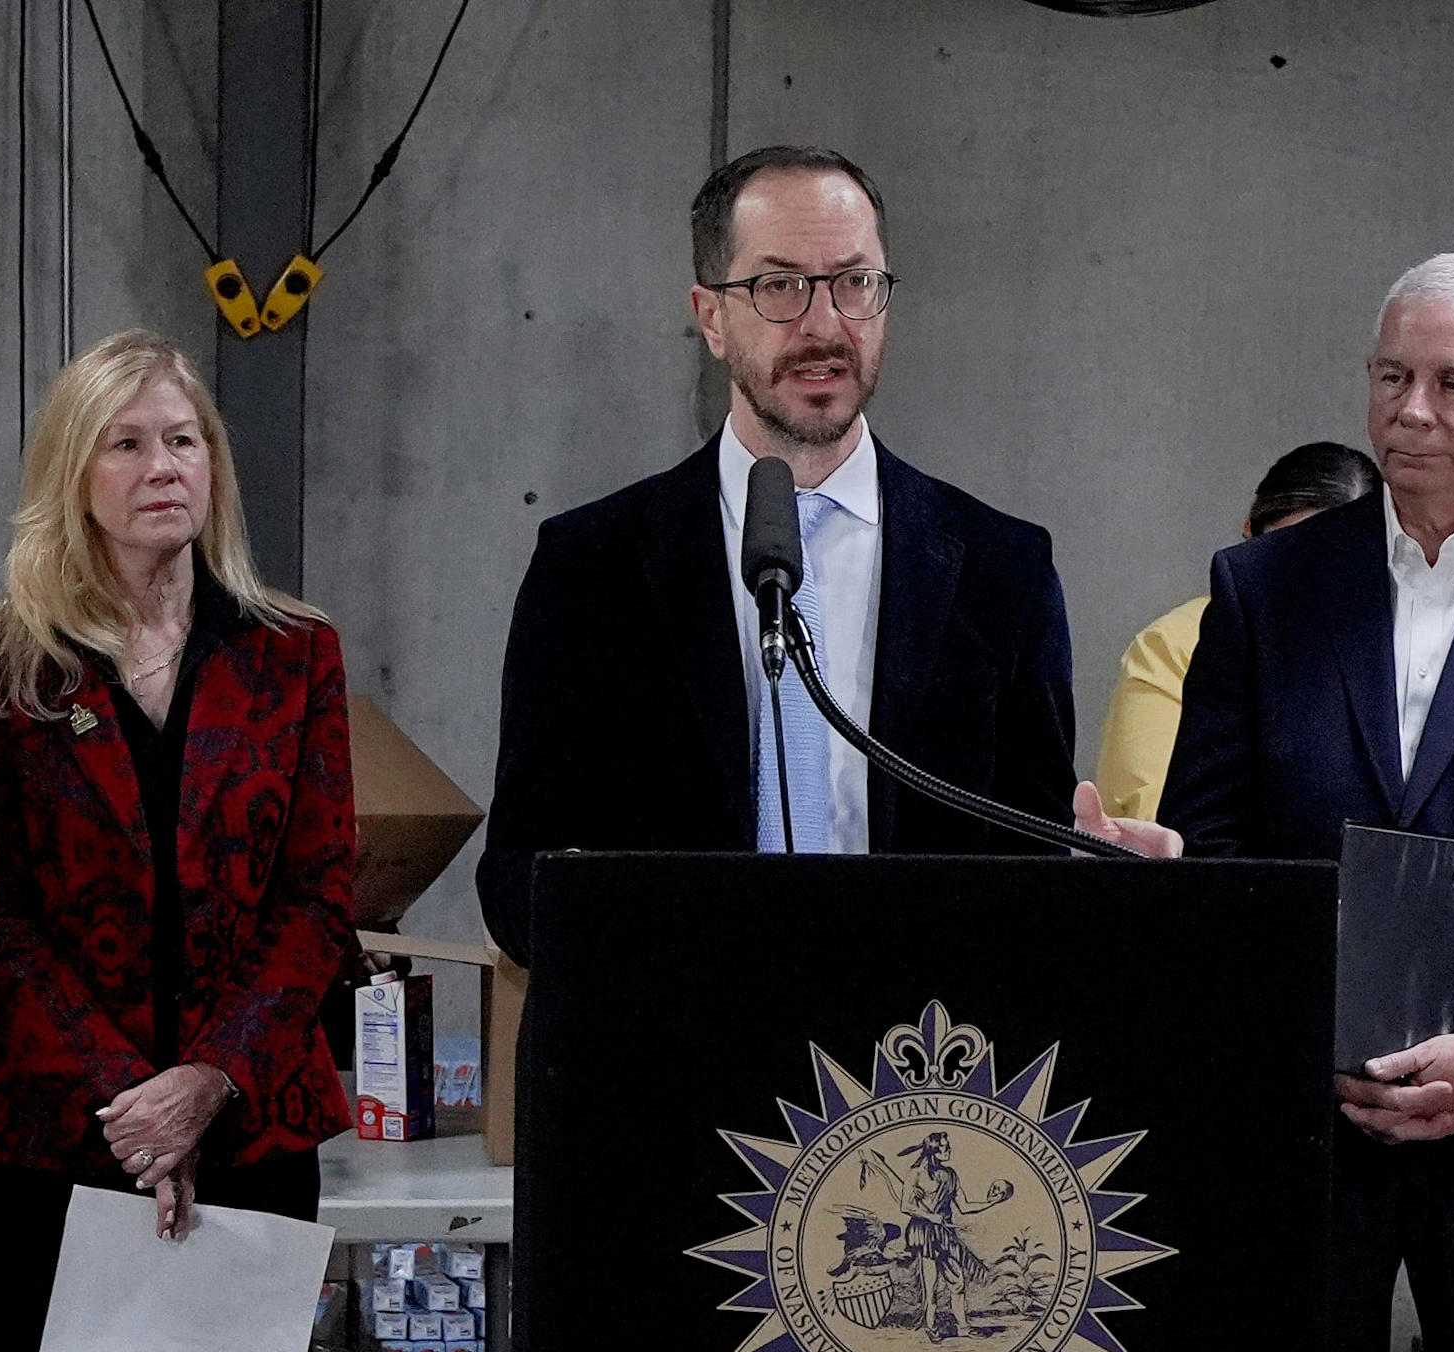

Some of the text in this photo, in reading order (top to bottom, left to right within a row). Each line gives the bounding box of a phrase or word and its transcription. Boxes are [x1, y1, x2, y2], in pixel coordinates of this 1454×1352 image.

[786, 1097, 1082, 1208] METROPOLITAN GOVERNMENT
[776, 1246, 796, 1278] OF
[1044, 1246, 1088, 1340] COUNTY
